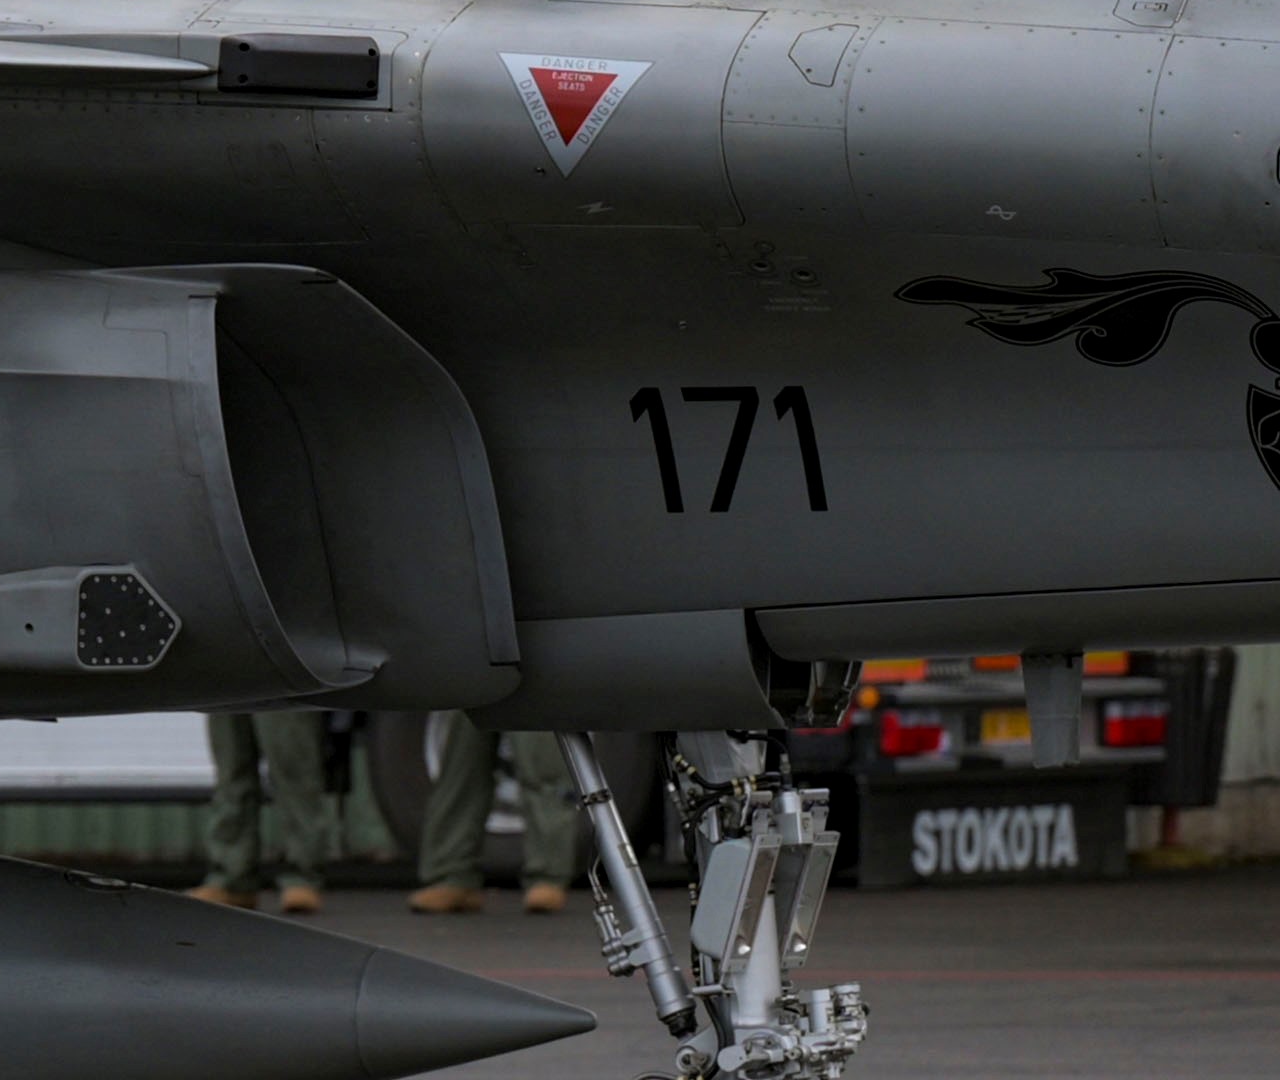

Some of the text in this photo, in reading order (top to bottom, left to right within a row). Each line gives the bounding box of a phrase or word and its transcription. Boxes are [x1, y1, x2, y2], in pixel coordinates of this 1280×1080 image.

[541, 57, 608, 71] DANGER
[551, 71, 593, 82] EJECTION
[557, 81, 586, 91] SEATS
[519, 79, 558, 142] DANGER
[576, 86, 623, 145] DANGER
[629, 385, 829, 513] 171
[911, 803, 1078, 875] STOKOTA
